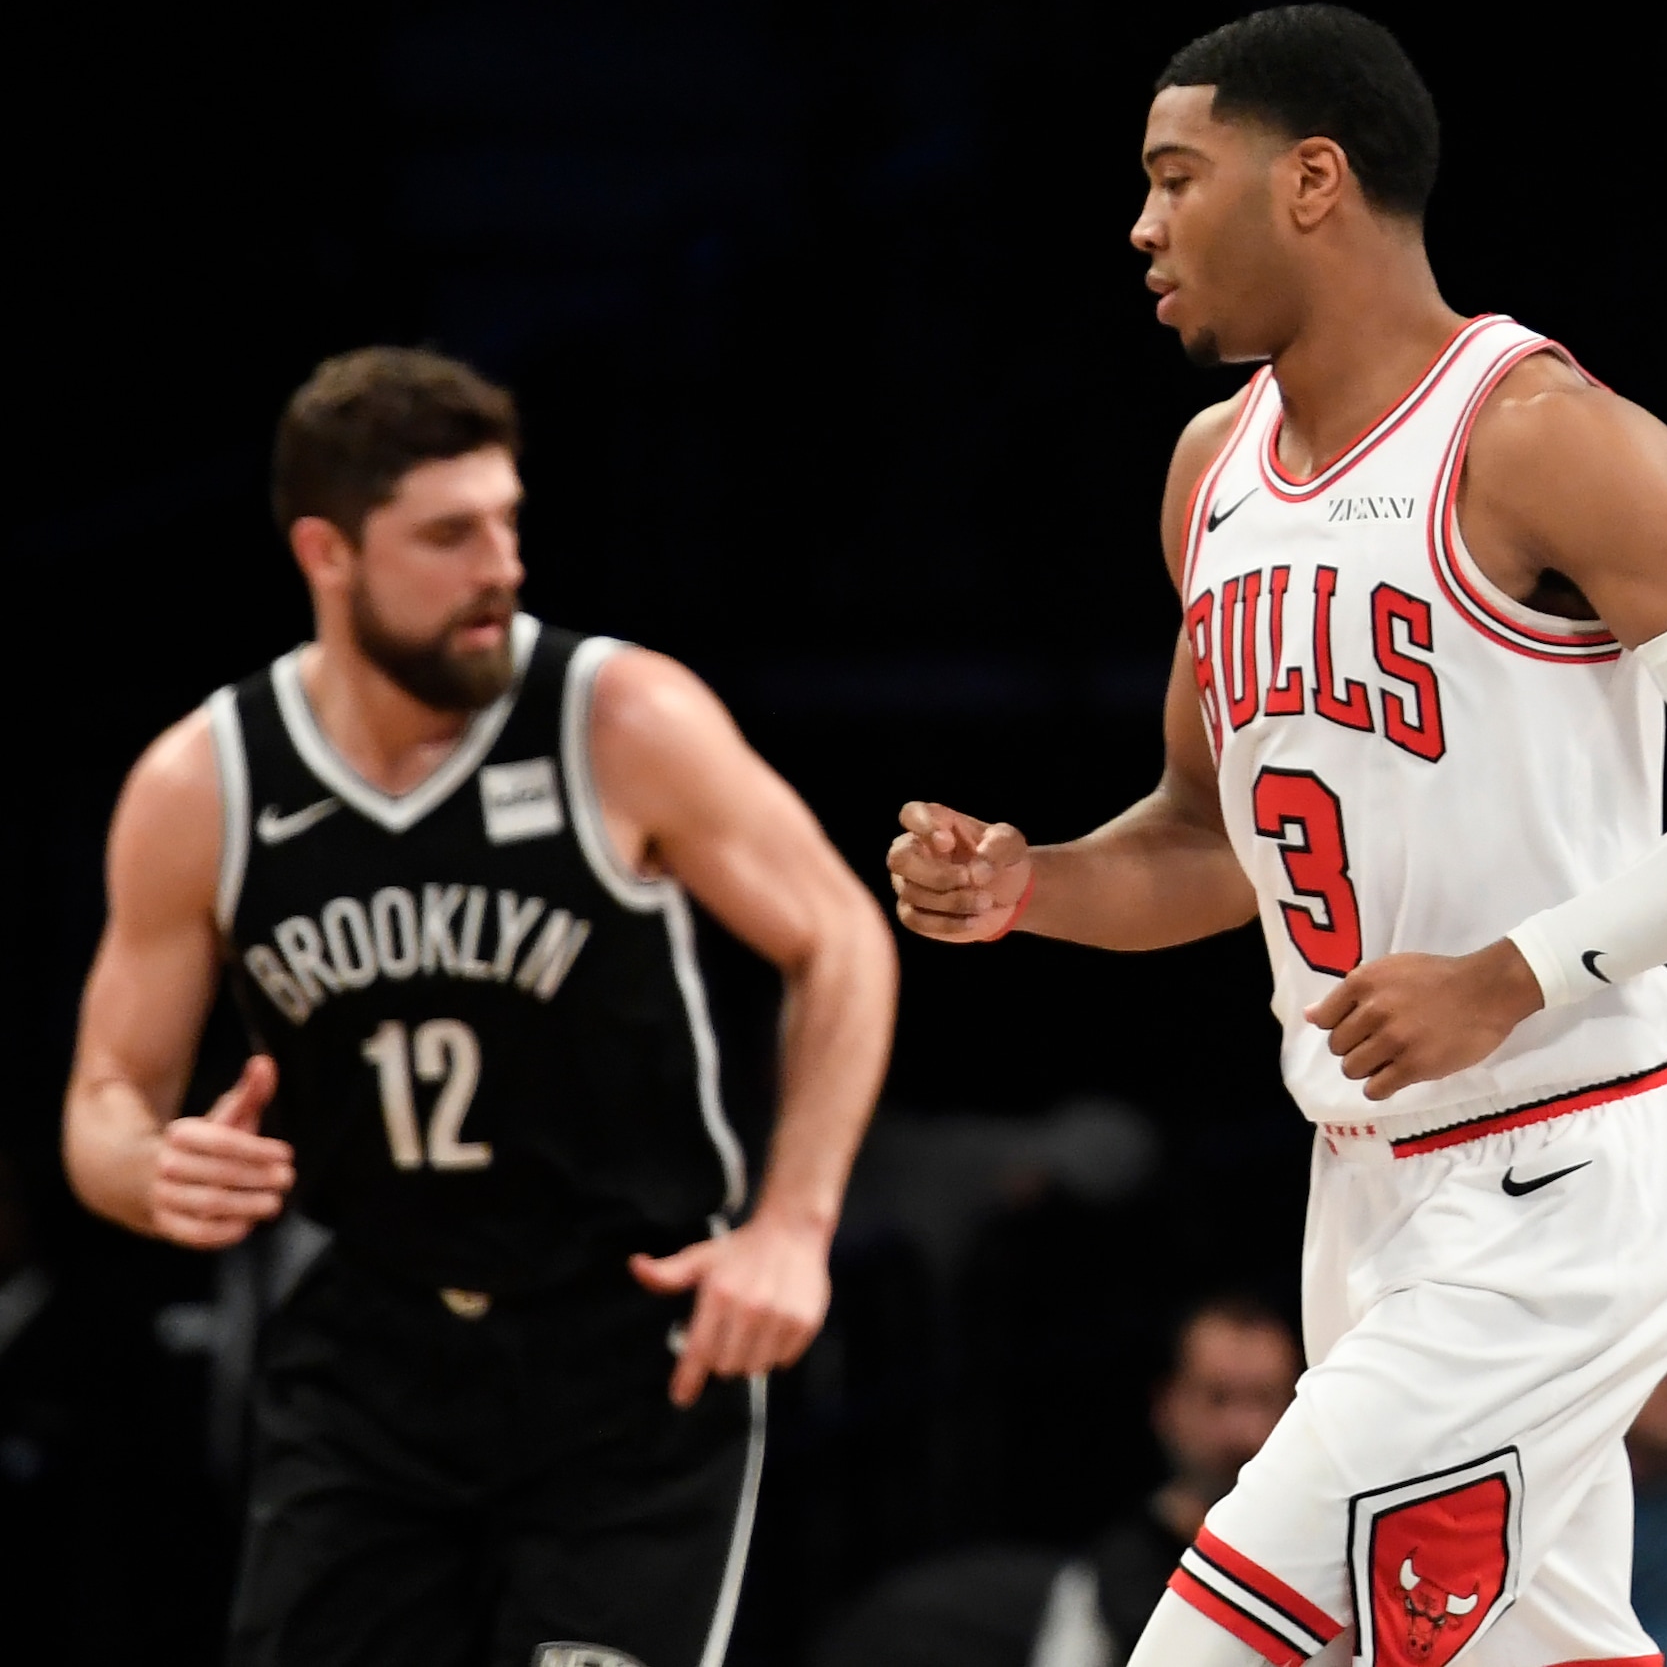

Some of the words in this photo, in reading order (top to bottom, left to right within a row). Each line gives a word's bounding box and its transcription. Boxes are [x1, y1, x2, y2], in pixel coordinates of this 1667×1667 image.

[1186, 564, 1446, 763] BULLS
[244, 882, 592, 1027] BROOKLYN
[1253, 765, 1362, 978] 3
[360, 1017, 494, 1171] 12
